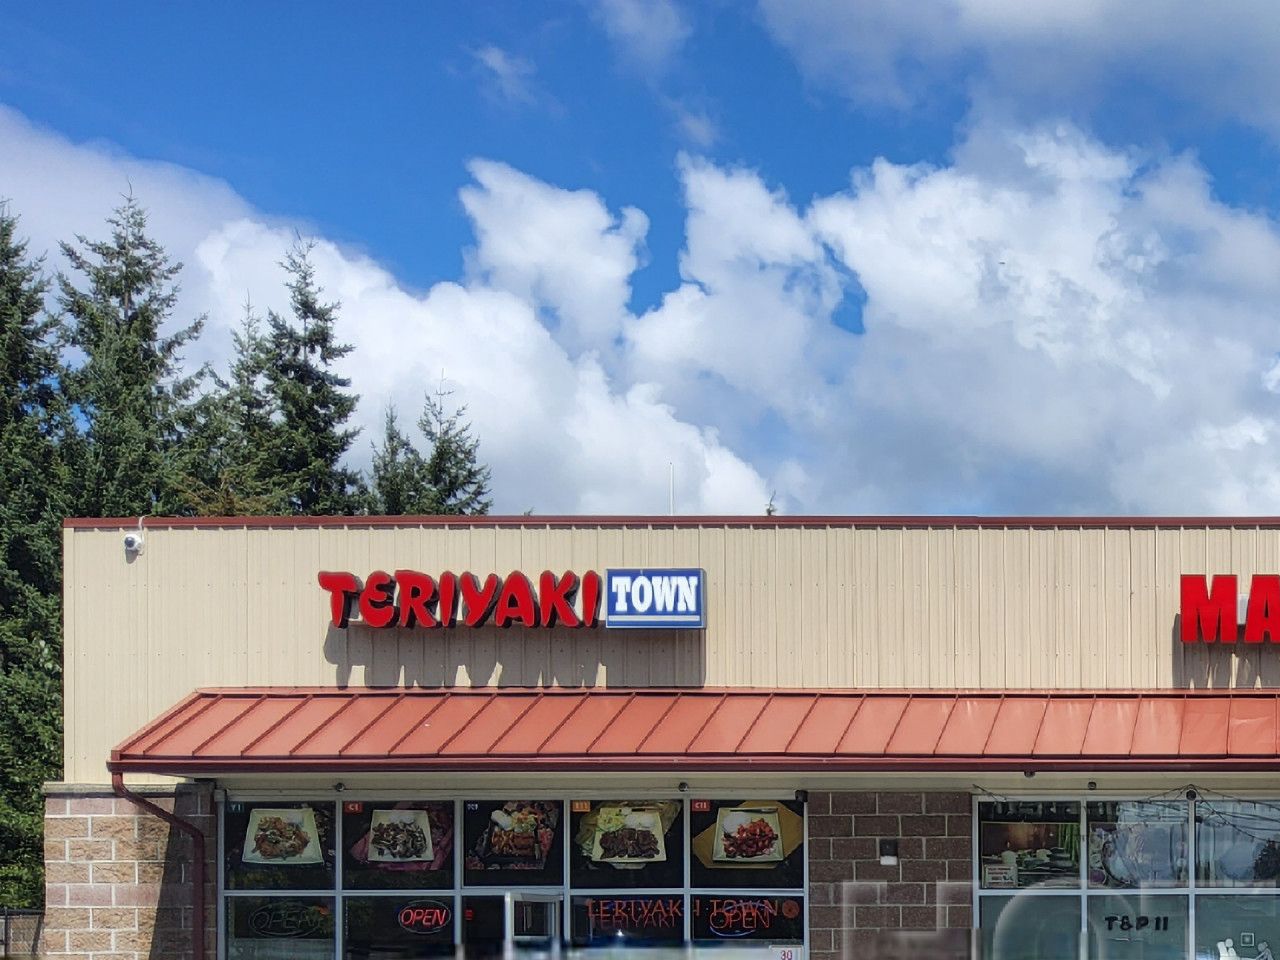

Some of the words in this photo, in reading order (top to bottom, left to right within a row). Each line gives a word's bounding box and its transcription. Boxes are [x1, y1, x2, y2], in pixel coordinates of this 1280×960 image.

[318, 569, 600, 629] TERIYAKI
[612, 575, 699, 613] TOWN
[401, 910, 446, 925] OPEN
[709, 911, 771, 929] OPEN
[780, 950, 793, 960] 30
